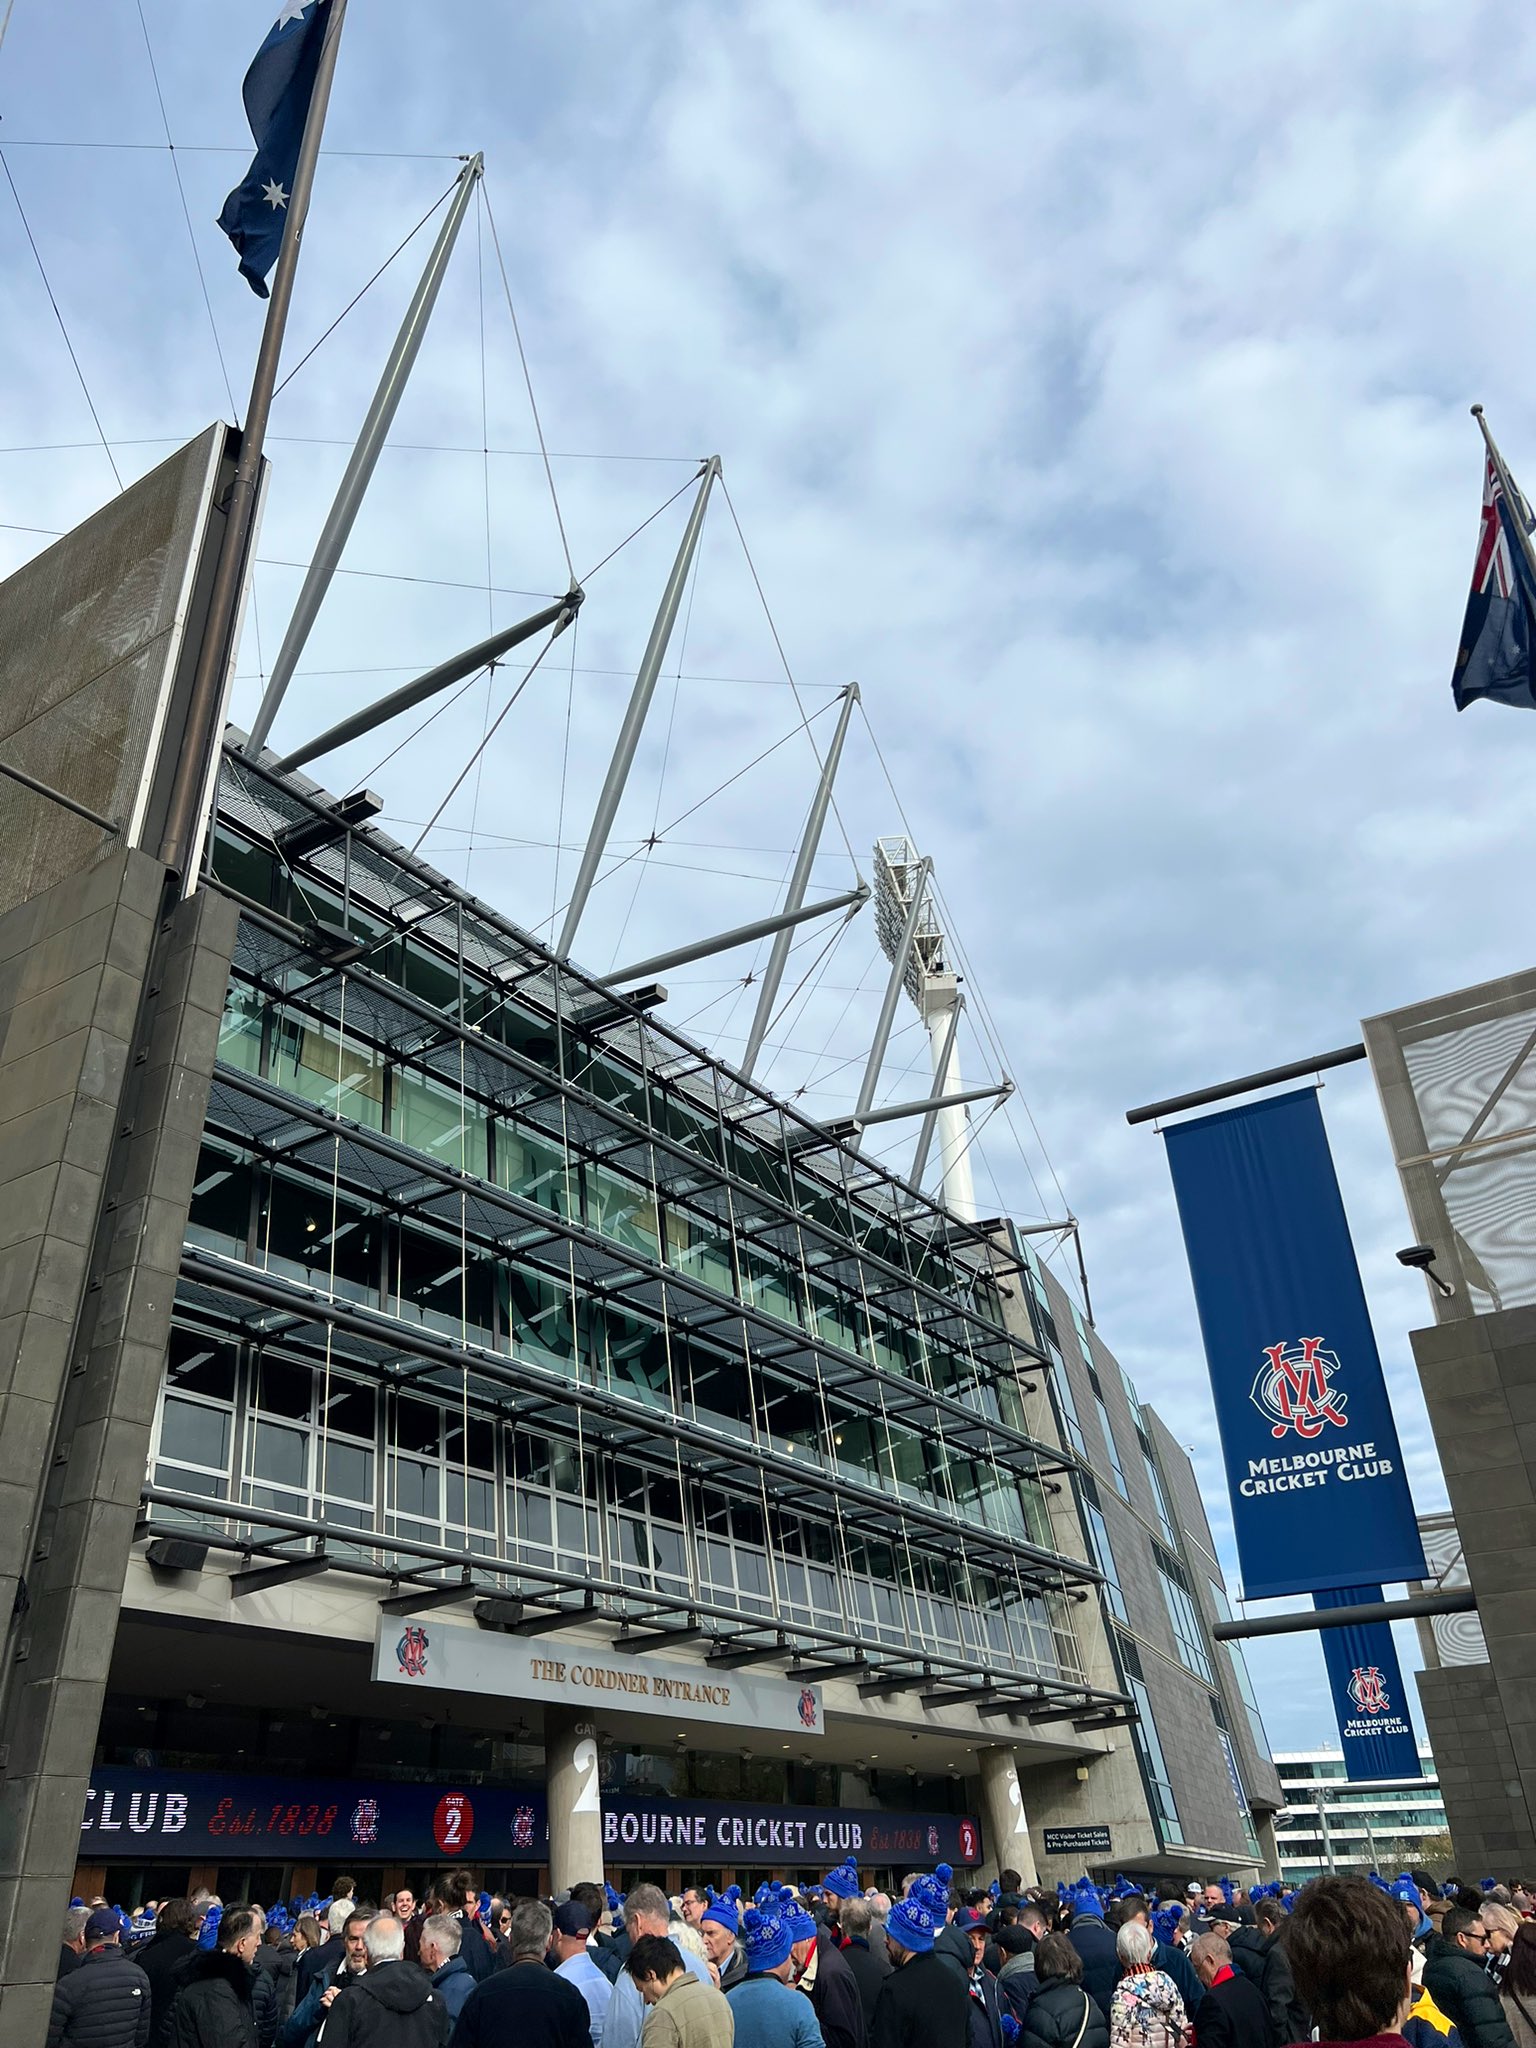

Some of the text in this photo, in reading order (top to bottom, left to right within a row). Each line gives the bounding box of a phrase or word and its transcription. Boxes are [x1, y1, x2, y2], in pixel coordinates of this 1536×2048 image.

[1248, 1442, 1377, 1477] MELBOURNE
[1239, 1459, 1393, 1497] CRICKET CLUB
[530, 1659, 731, 1706] THE CORDNER ENTRANCE
[574, 1723, 597, 1737] GAT
[1344, 1725, 1408, 1737] CRICKET CLUB
[1347, 1717, 1401, 1729] MELBOURNE
[443, 1807, 462, 1844] 2
[717, 1817, 807, 1848] CRICKET
[815, 1822, 863, 1849] CLUB
[1060, 1832, 1076, 1840] Visitor
[1077, 1831, 1093, 1839] Ticket
[1093, 1830, 1107, 1838] Sales
[964, 1830, 973, 1856] 2
[1052, 1839, 1091, 1848] Pre-Purchased
[1091, 1838, 1109, 1846] Tickets
